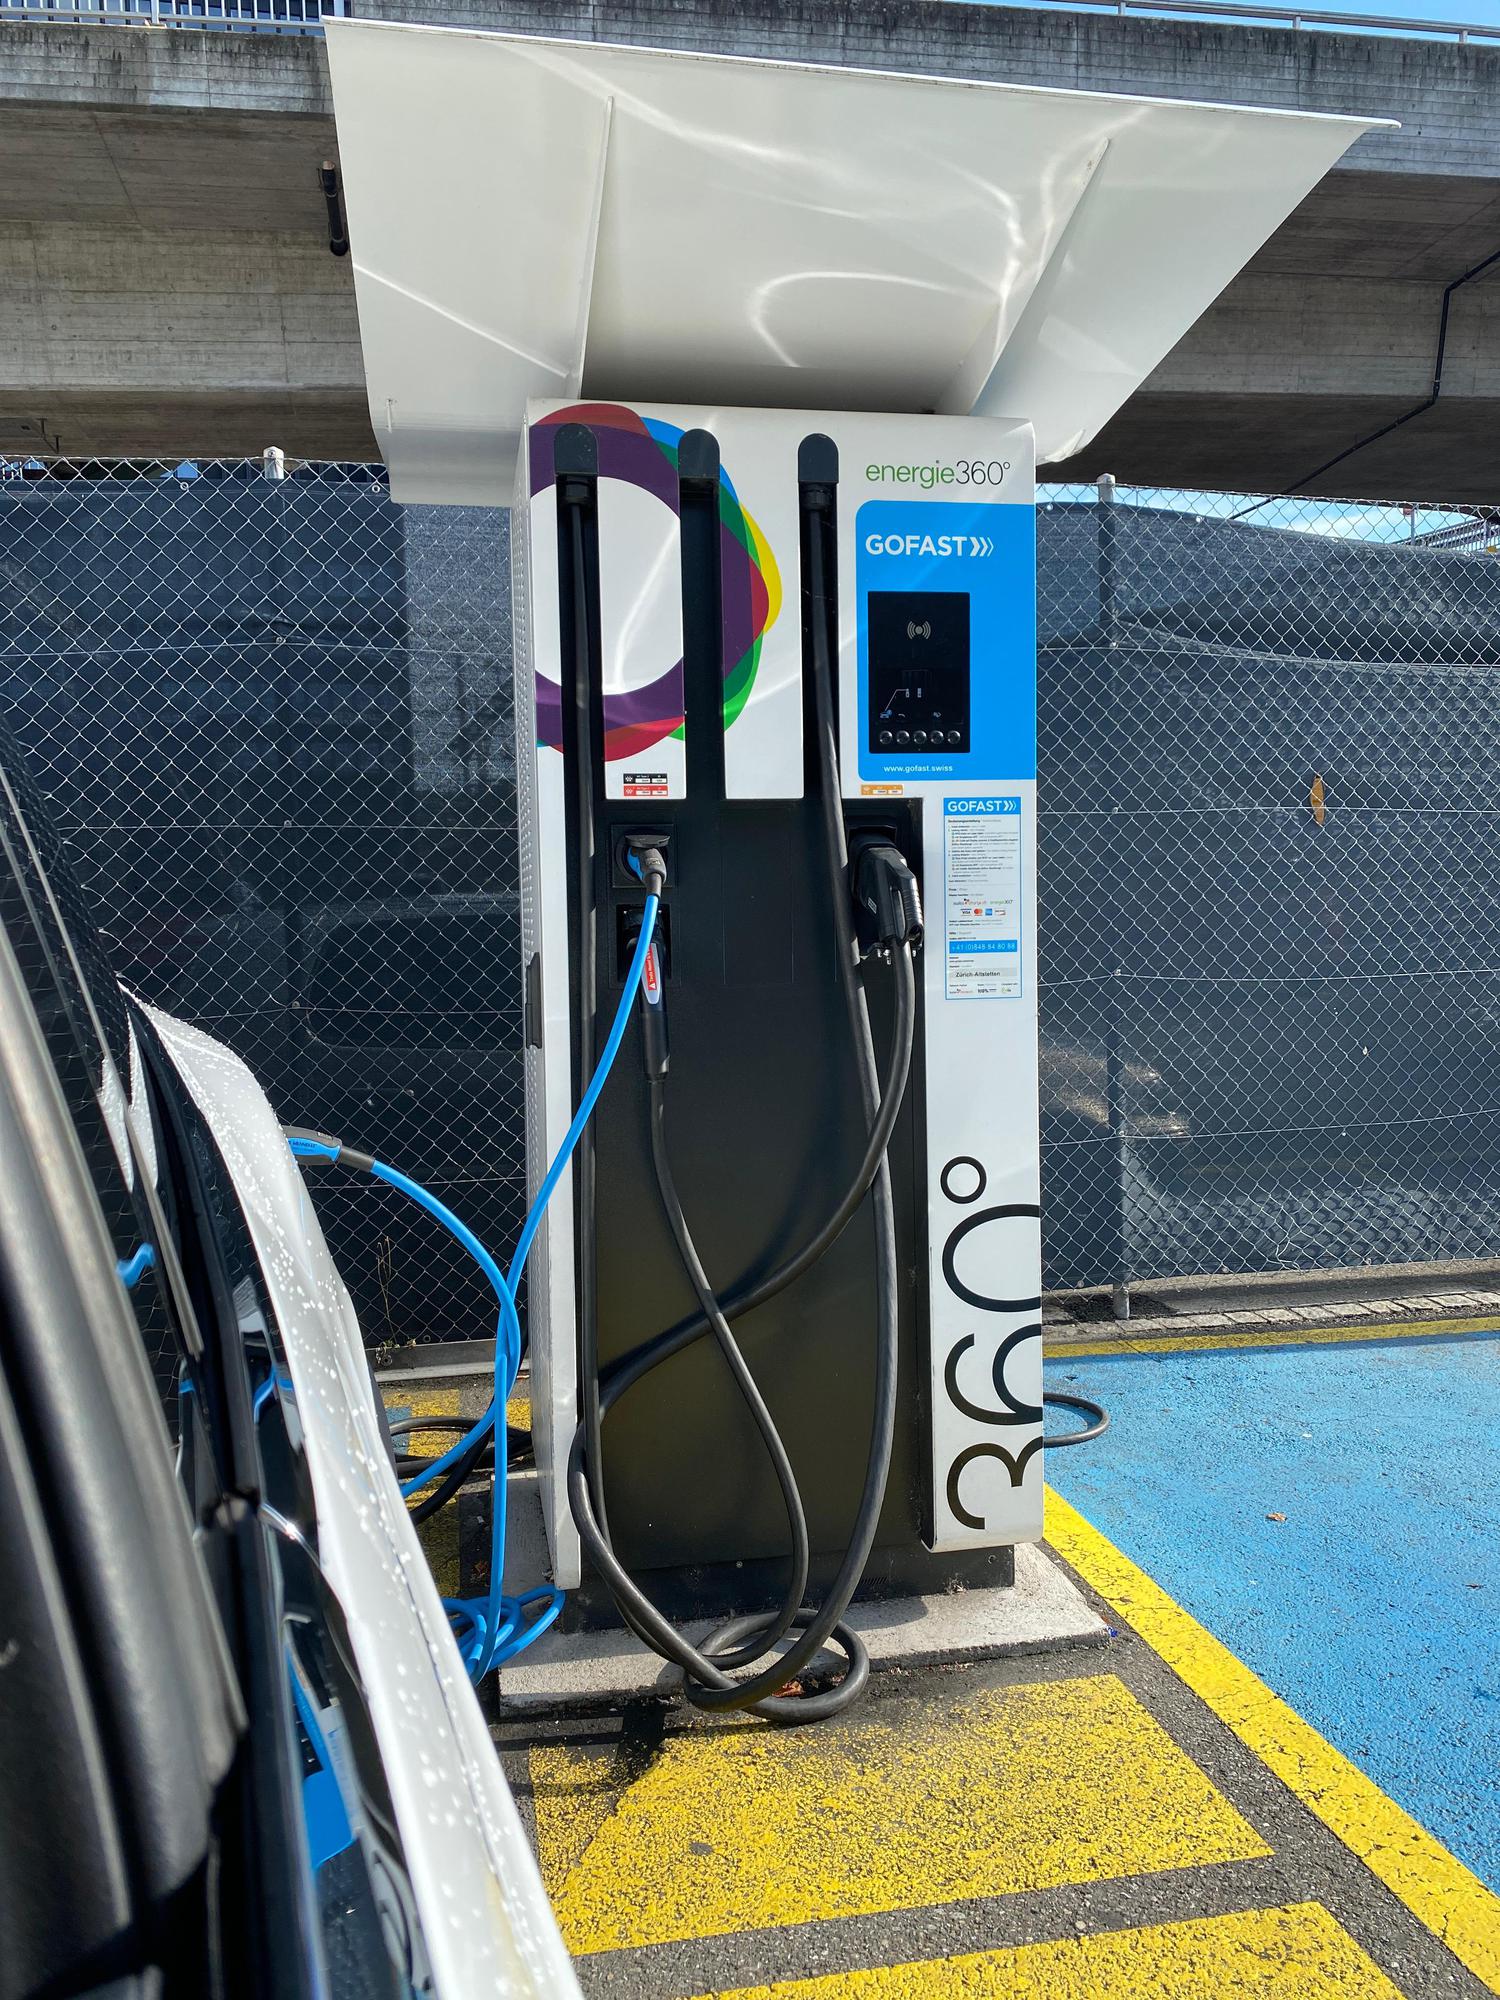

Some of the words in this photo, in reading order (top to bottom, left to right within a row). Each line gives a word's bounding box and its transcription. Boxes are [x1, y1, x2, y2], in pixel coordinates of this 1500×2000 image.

[866, 460, 1010, 489] energie360°
[865, 534, 968, 557] GOFAST
[883, 764, 953, 773] www.gofast.swiss
[947, 800, 1002, 812] GOFAST
[940, 1155, 1044, 1530] 360°
